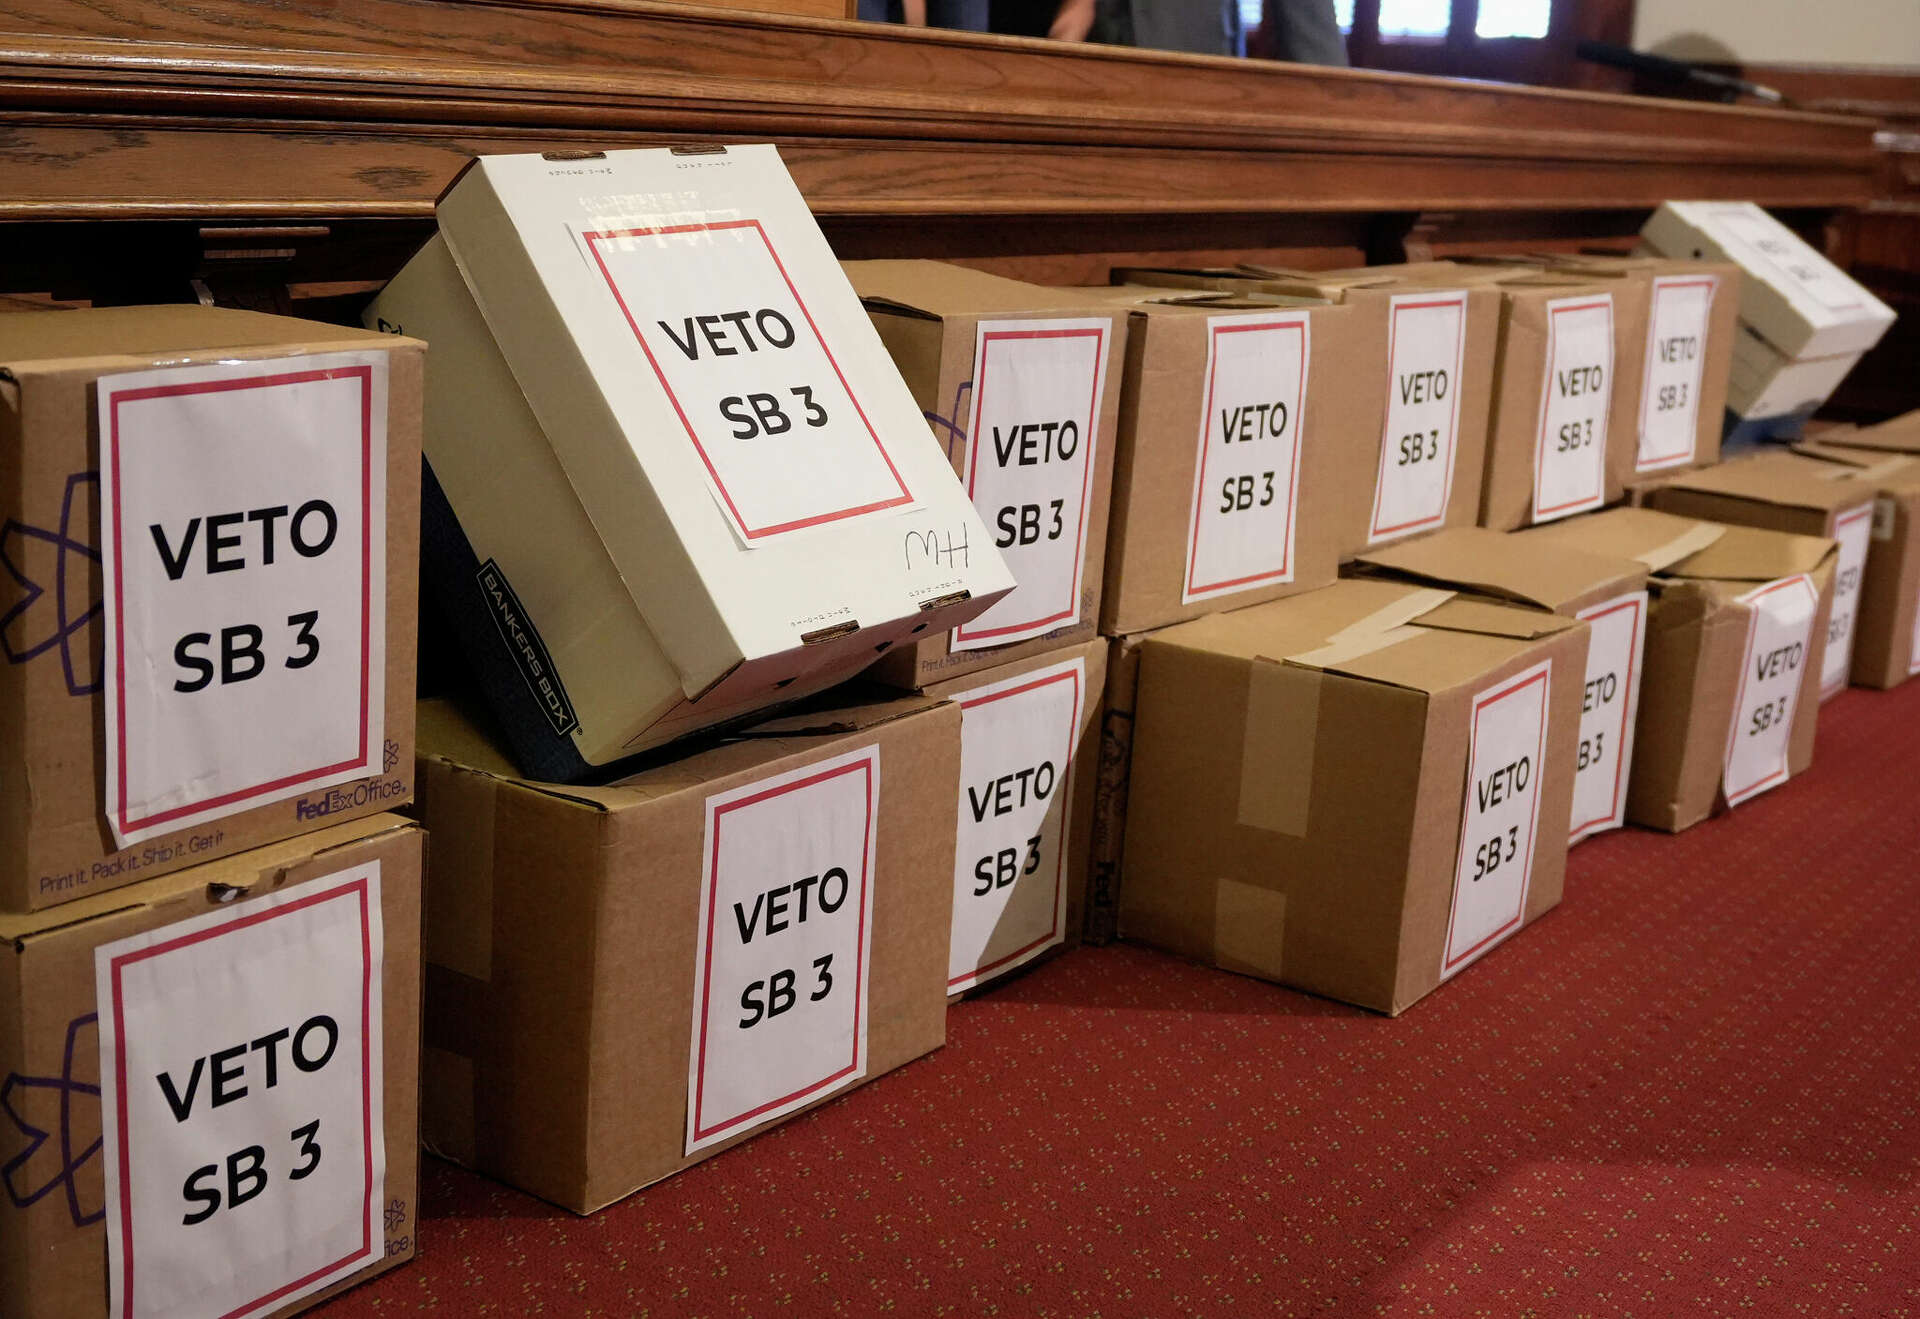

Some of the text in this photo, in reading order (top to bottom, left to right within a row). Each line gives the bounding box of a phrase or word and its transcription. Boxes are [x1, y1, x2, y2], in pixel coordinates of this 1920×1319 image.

[657, 308, 796, 361] VETO
[1659, 336, 1697, 363] VETO
[1401, 370, 1447, 404] VETO
[1559, 366, 1601, 396] VETO
[1657, 383, 1688, 411] SB 3
[718, 385, 829, 440] SB 3
[1223, 402, 1287, 443] VETO
[1558, 422, 1594, 452] SB 3
[993, 420, 1078, 467] VETO
[1399, 430, 1438, 465] SB 3
[1221, 472, 1274, 513] SB 3
[150, 500, 337, 580] VETO
[905, 522, 968, 570] MH
[996, 499, 1063, 548] SB 3
[173, 611, 319, 693] SB 3
[484, 573, 568, 727] BANKERS BOX
[1757, 642, 1802, 681] VETO
[1583, 671, 1617, 713] ETO
[1749, 696, 1787, 736] SB 3
[1577, 731, 1604, 772] B 3
[968, 760, 1055, 823] VETO
[1479, 757, 1529, 813] VETO
[40, 874, 73, 894] Print
[92, 859, 125, 880] Pack
[142, 848, 172, 866] Ship
[189, 835, 213, 853] Get
[973, 835, 1042, 897] SB 3
[1473, 826, 1518, 882] SB 3
[734, 867, 848, 944] VETO
[739, 954, 833, 1028] SB 3
[156, 1015, 339, 1122] VETO
[183, 1119, 321, 1225] SB 3
